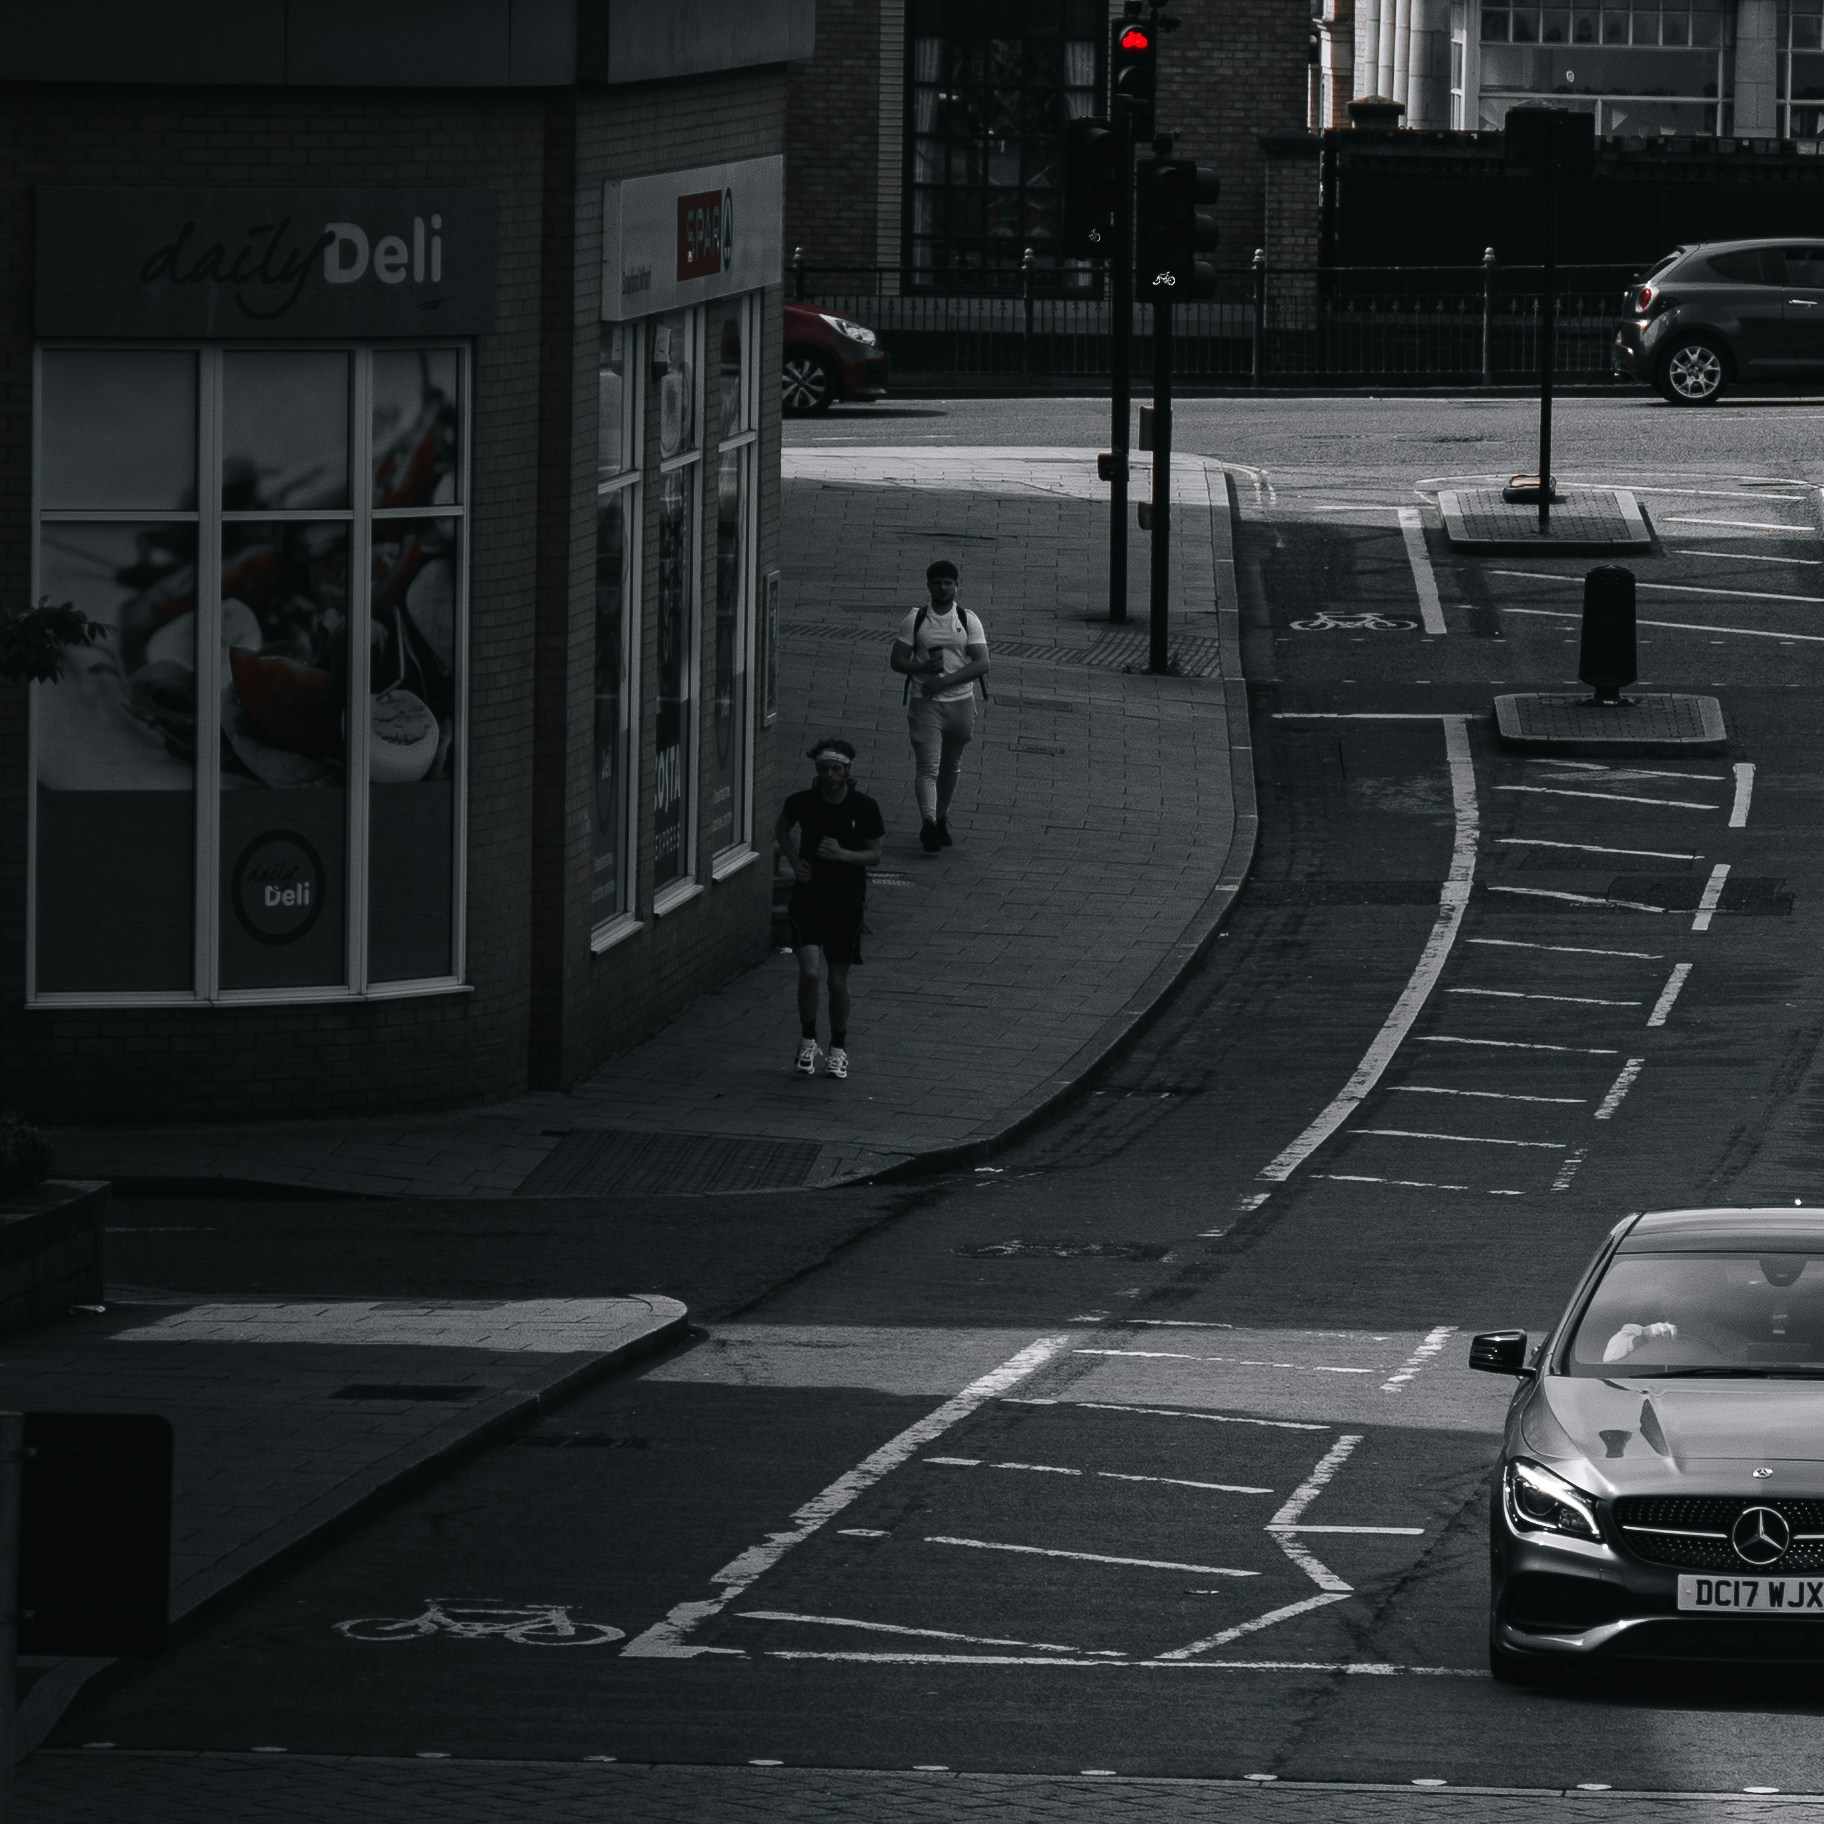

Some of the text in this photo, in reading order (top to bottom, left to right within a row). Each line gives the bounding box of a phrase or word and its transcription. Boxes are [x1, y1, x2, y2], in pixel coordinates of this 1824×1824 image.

[687, 204, 721, 263] SPAR
[140, 213, 442, 319] daily Deli
[264, 880, 310, 907] Deli
[1696, 1579, 1824, 1608] DC17 WJX
